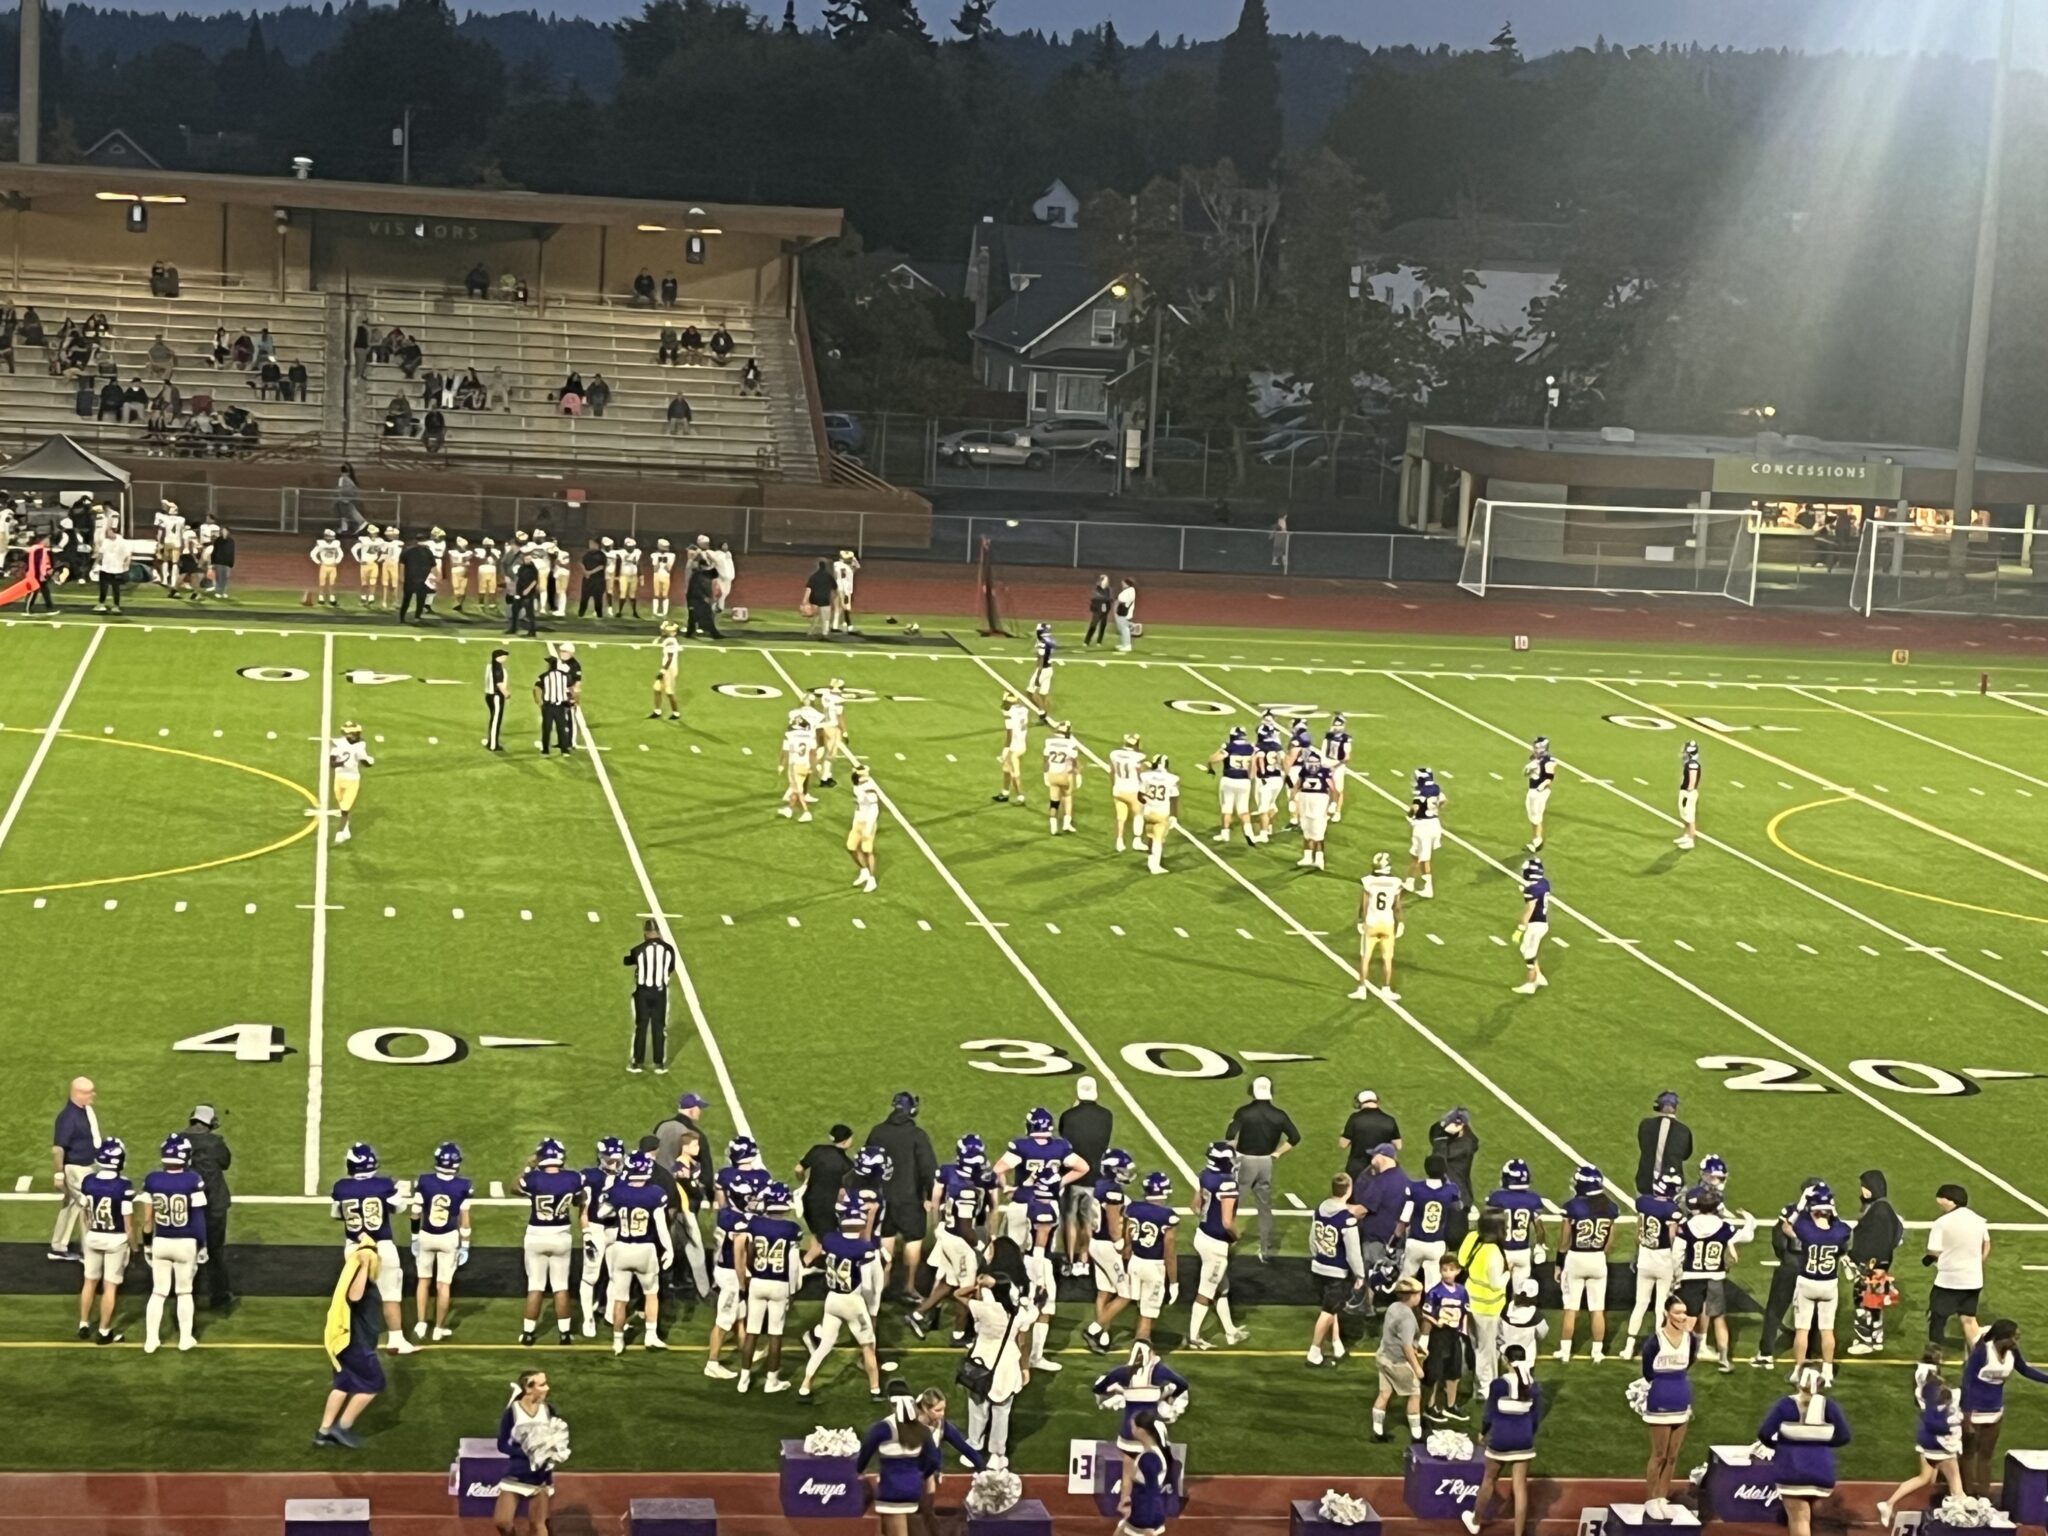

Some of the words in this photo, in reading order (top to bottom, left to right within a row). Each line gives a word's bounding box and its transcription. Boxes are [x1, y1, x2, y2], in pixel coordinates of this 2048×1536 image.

[369, 221, 478, 240] VISORS
[1751, 463, 1865, 478] CONCESSIONS
[1149, 784, 1166, 801] 33
[1376, 892, 1387, 910] 6
[753, 1236, 787, 1273] 34
[1806, 1244, 1838, 1275] 15
[799, 1478, 846, 1505] Amya
